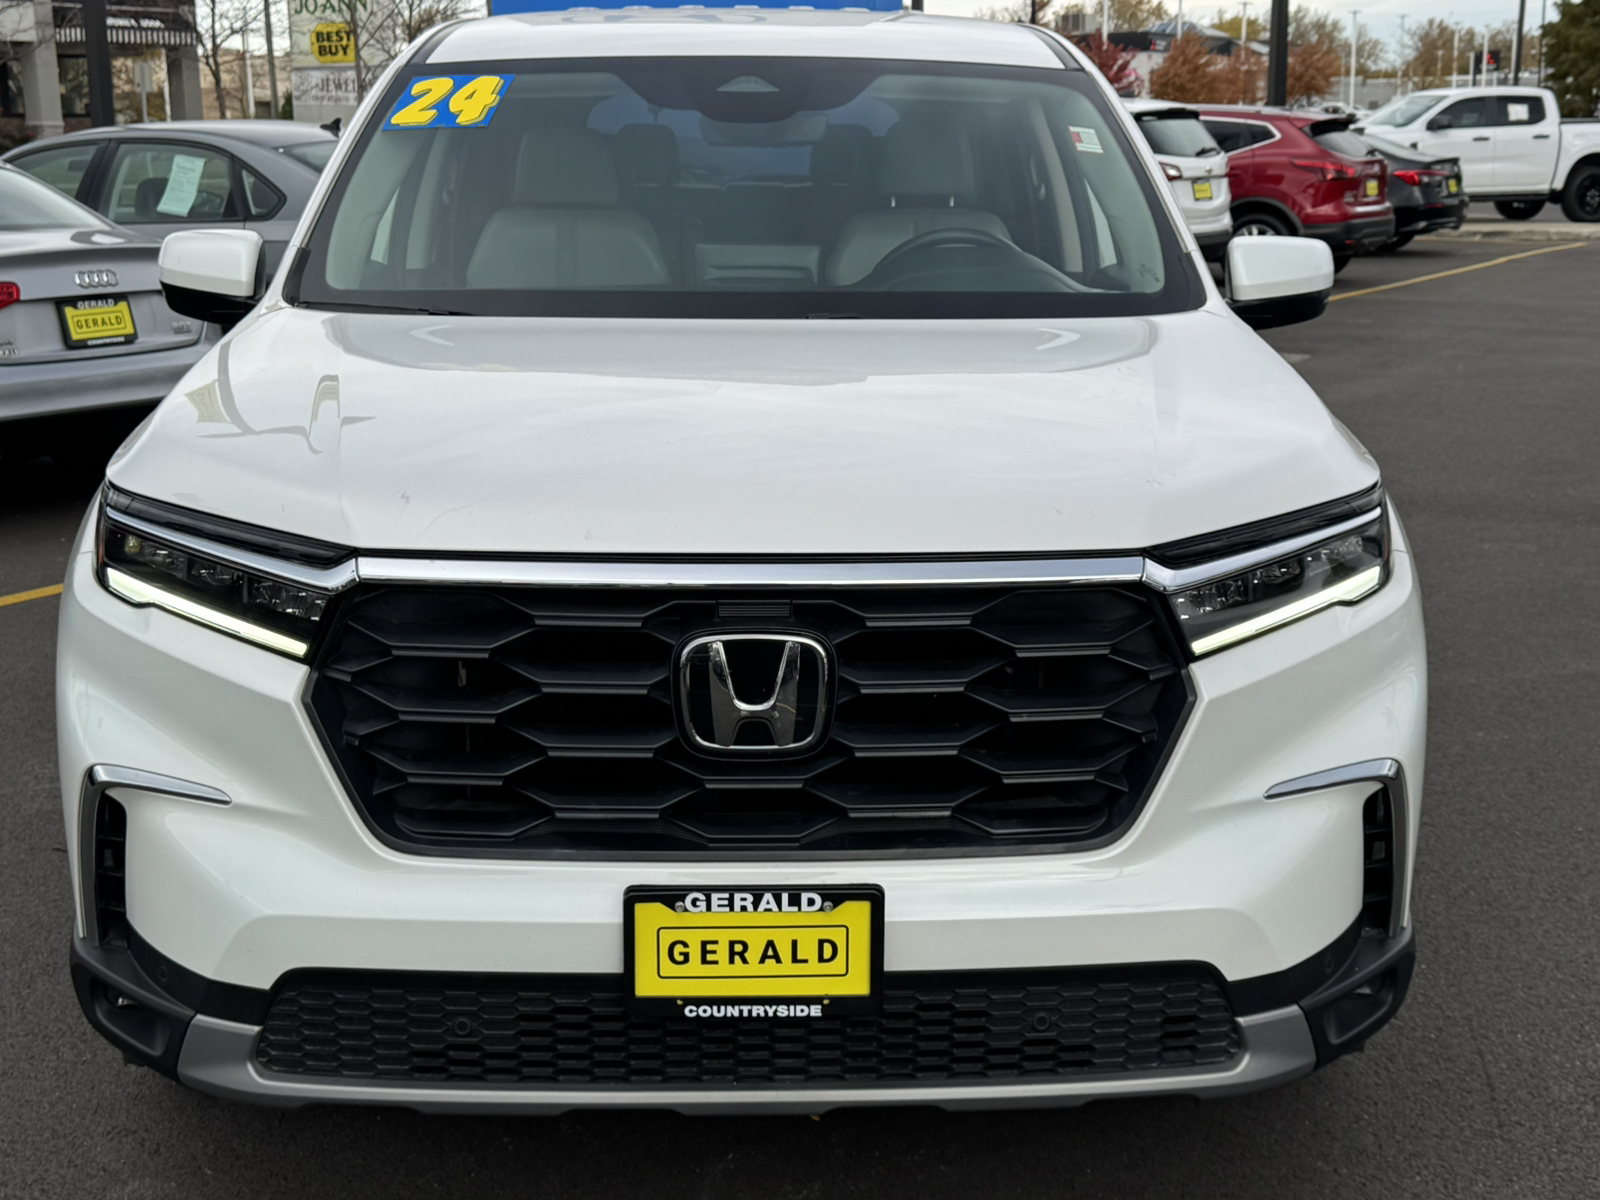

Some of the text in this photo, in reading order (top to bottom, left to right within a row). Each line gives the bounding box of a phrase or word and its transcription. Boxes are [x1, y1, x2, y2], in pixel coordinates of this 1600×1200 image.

[316, 30, 352, 43] BEST
[318, 45, 349, 56] BUY
[391, 76, 504, 125] 24
[77, 298, 115, 310] GERALD
[76, 315, 123, 330] GERALD
[684, 892, 822, 912] GERALD
[667, 939, 839, 965] GERALD
[684, 1004, 822, 1017] COUNTRYSIDE
